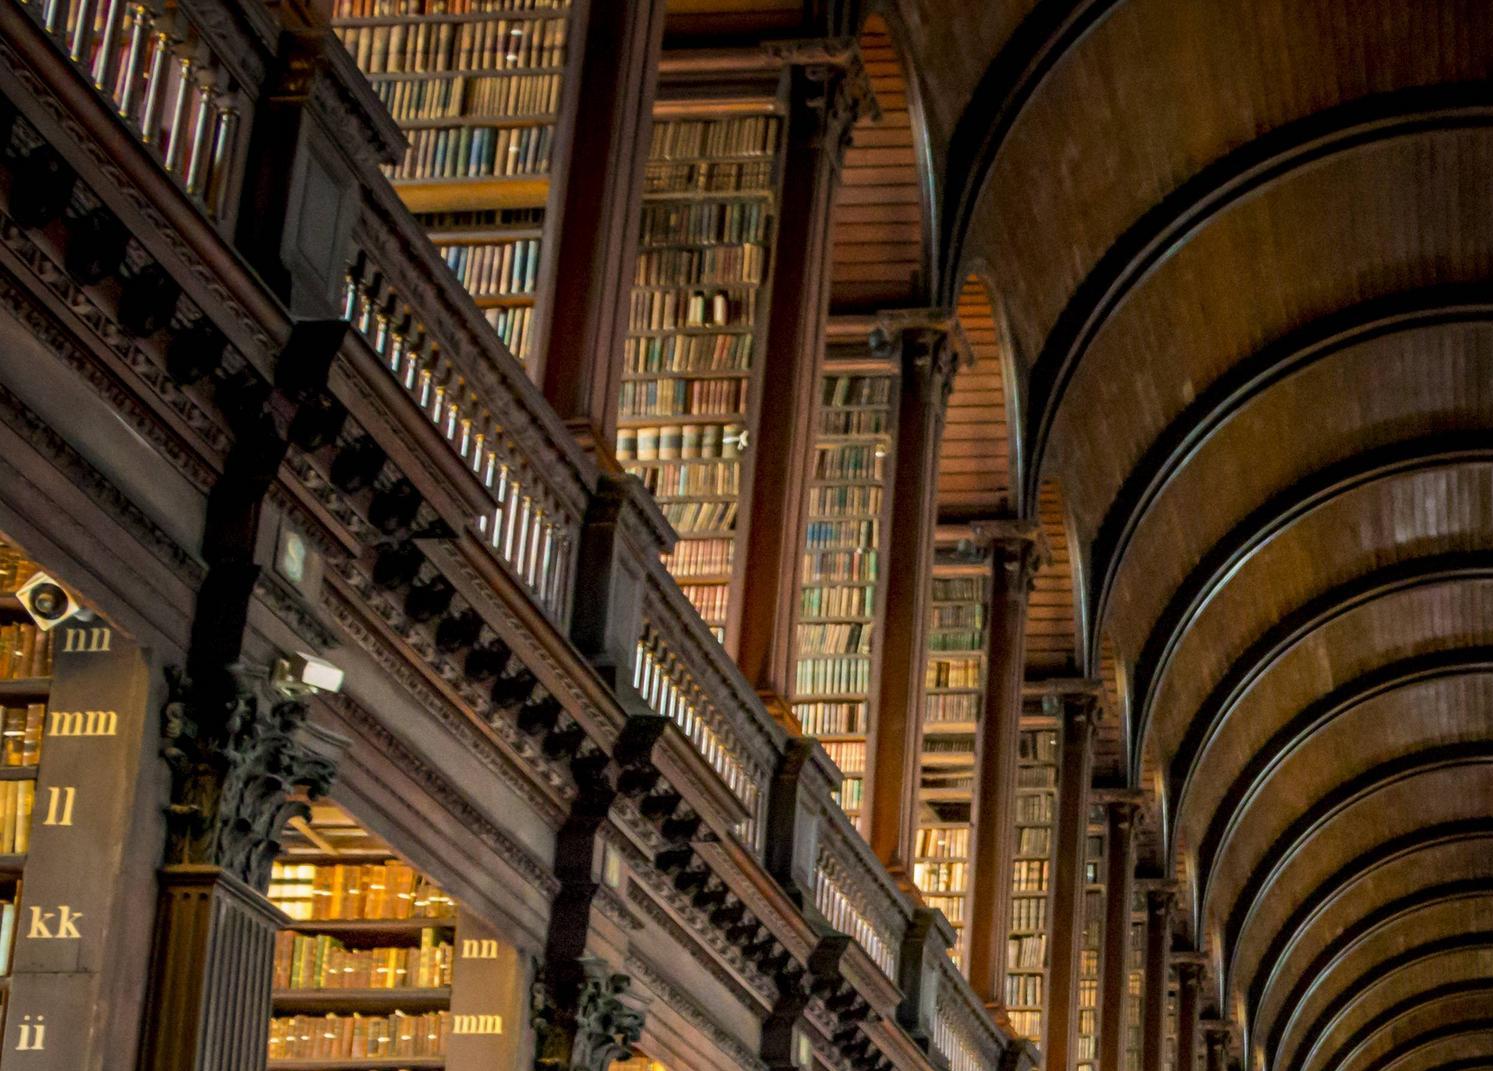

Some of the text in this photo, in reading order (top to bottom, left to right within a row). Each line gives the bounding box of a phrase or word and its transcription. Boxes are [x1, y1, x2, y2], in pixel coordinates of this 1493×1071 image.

[63, 627, 111, 653] nn
[48, 710, 118, 737] mm
[43, 786, 76, 826] ll
[26, 905, 83, 939] kk
[461, 939, 498, 959] nn
[15, 1015, 45, 1051] ii
[452, 1014, 503, 1035] mm
